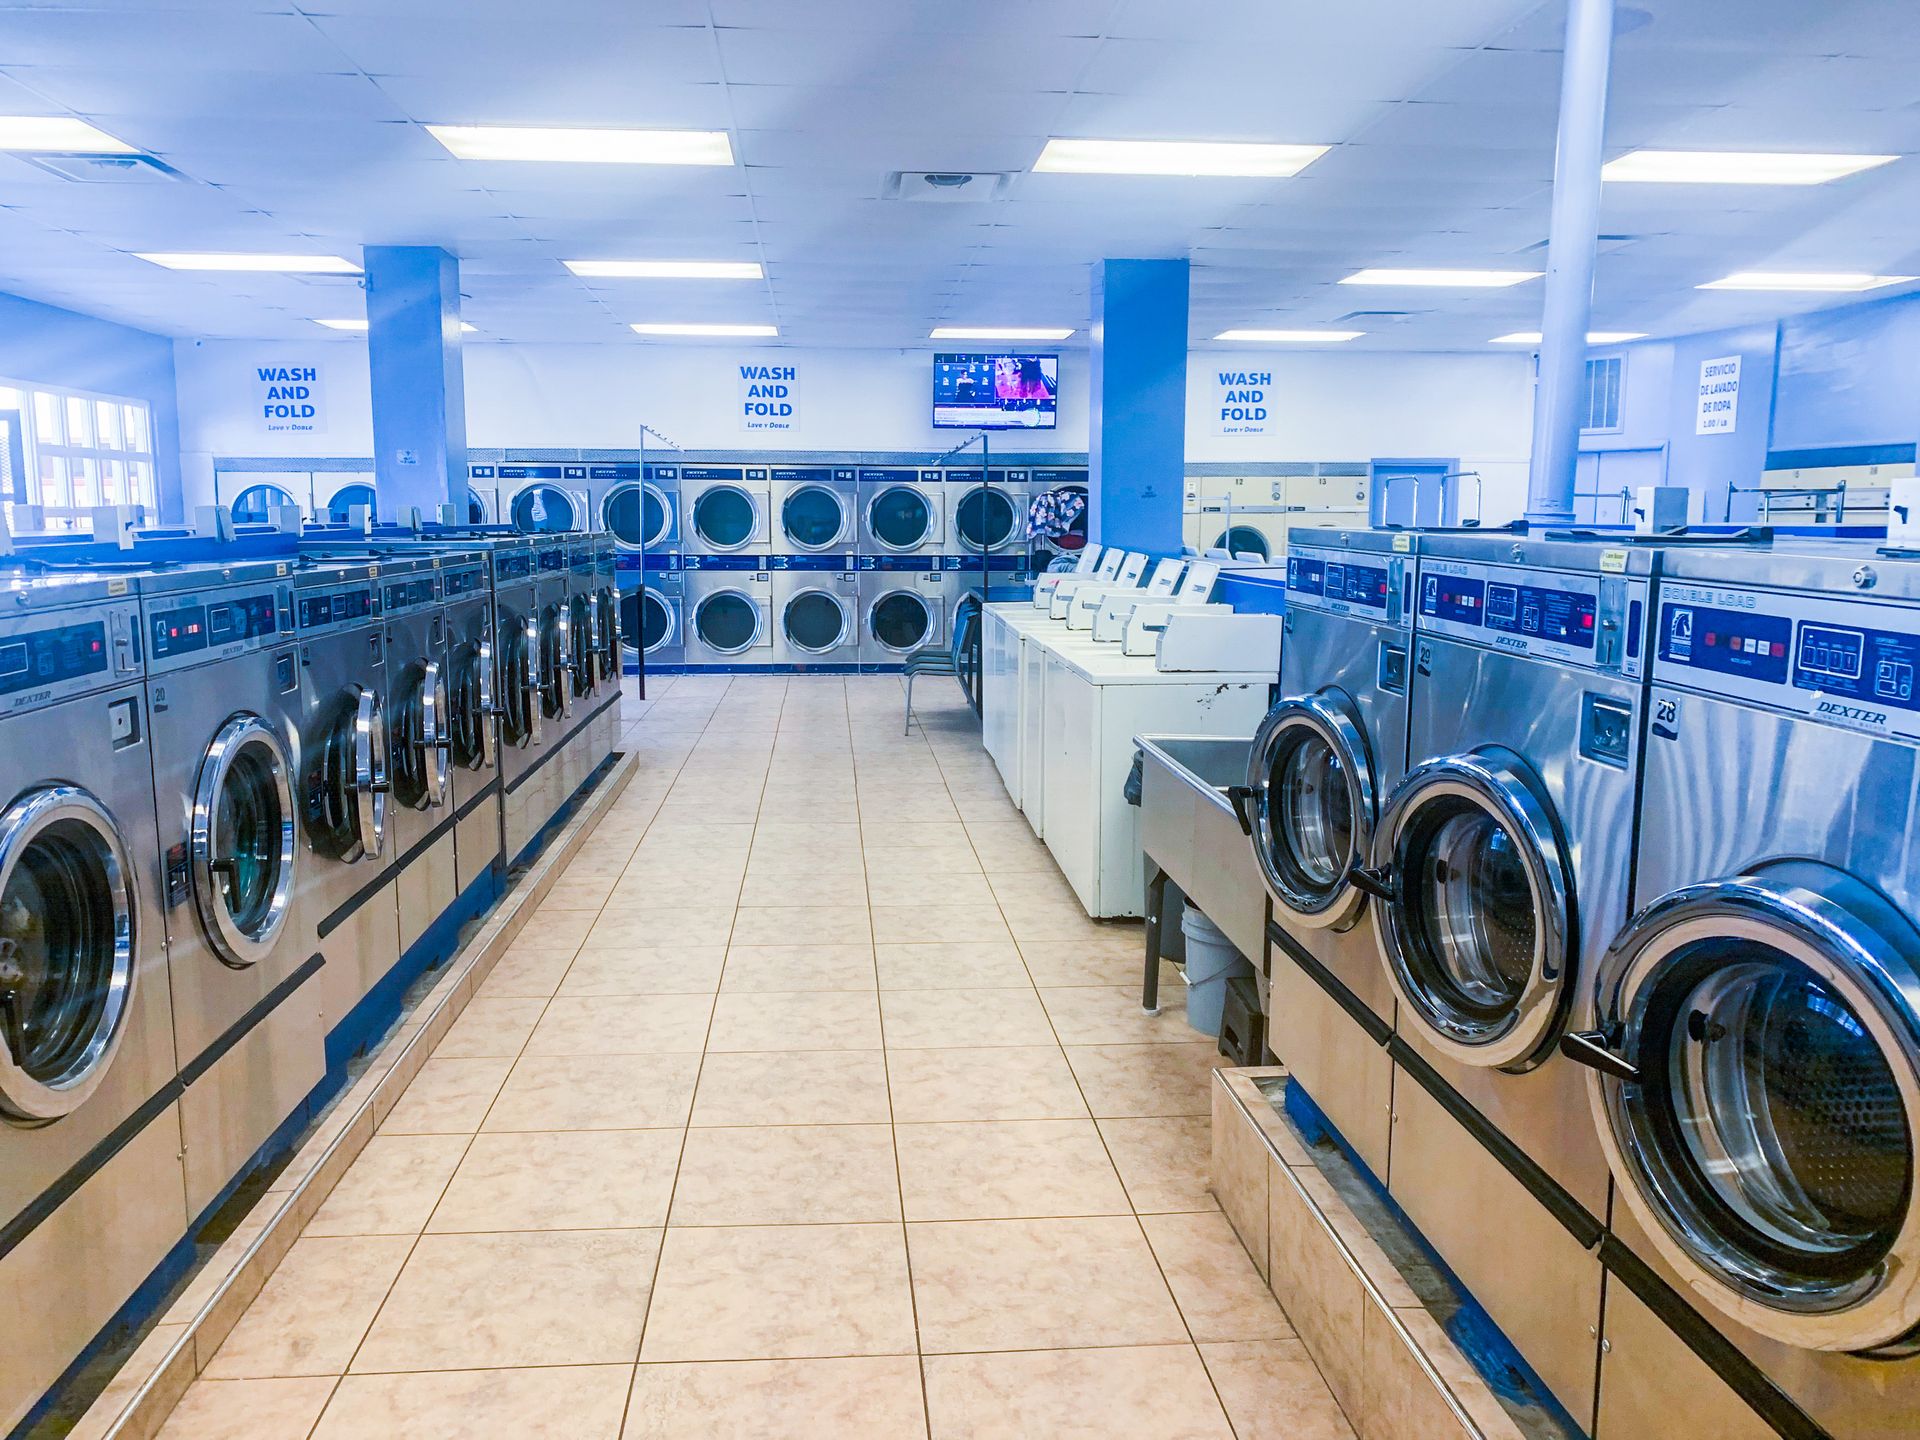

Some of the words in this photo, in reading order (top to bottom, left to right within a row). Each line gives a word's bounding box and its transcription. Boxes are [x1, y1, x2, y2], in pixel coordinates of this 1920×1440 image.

[257, 368, 316, 381] WASH
[740, 366, 795, 380] WASH
[1705, 363, 1736, 377] SERVICIO
[1219, 373, 1271, 385] WASH
[267, 386, 310, 399] AND
[748, 385, 788, 398] AND
[1701, 385, 1709, 395] DE
[1710, 381, 1737, 395] LAVADO
[1225, 391, 1264, 403] AND
[264, 405, 315, 418] FOLD
[744, 403, 792, 416] FOLD
[1703, 402, 1712, 413] DE
[1713, 400, 1731, 412] ROPA
[1221, 408, 1267, 421] FOLD
[1663, 587, 1713, 603] DOUBLE
[1718, 593, 1756, 608] LOAD
[1496, 636, 1528, 649] DEXTER
[1420, 647, 1430, 664] 29
[14, 690, 51, 706] DEXTER
[155, 687, 165, 702] 20
[1657, 699, 1676, 723] 28
[1816, 701, 1887, 724] DEXTER
